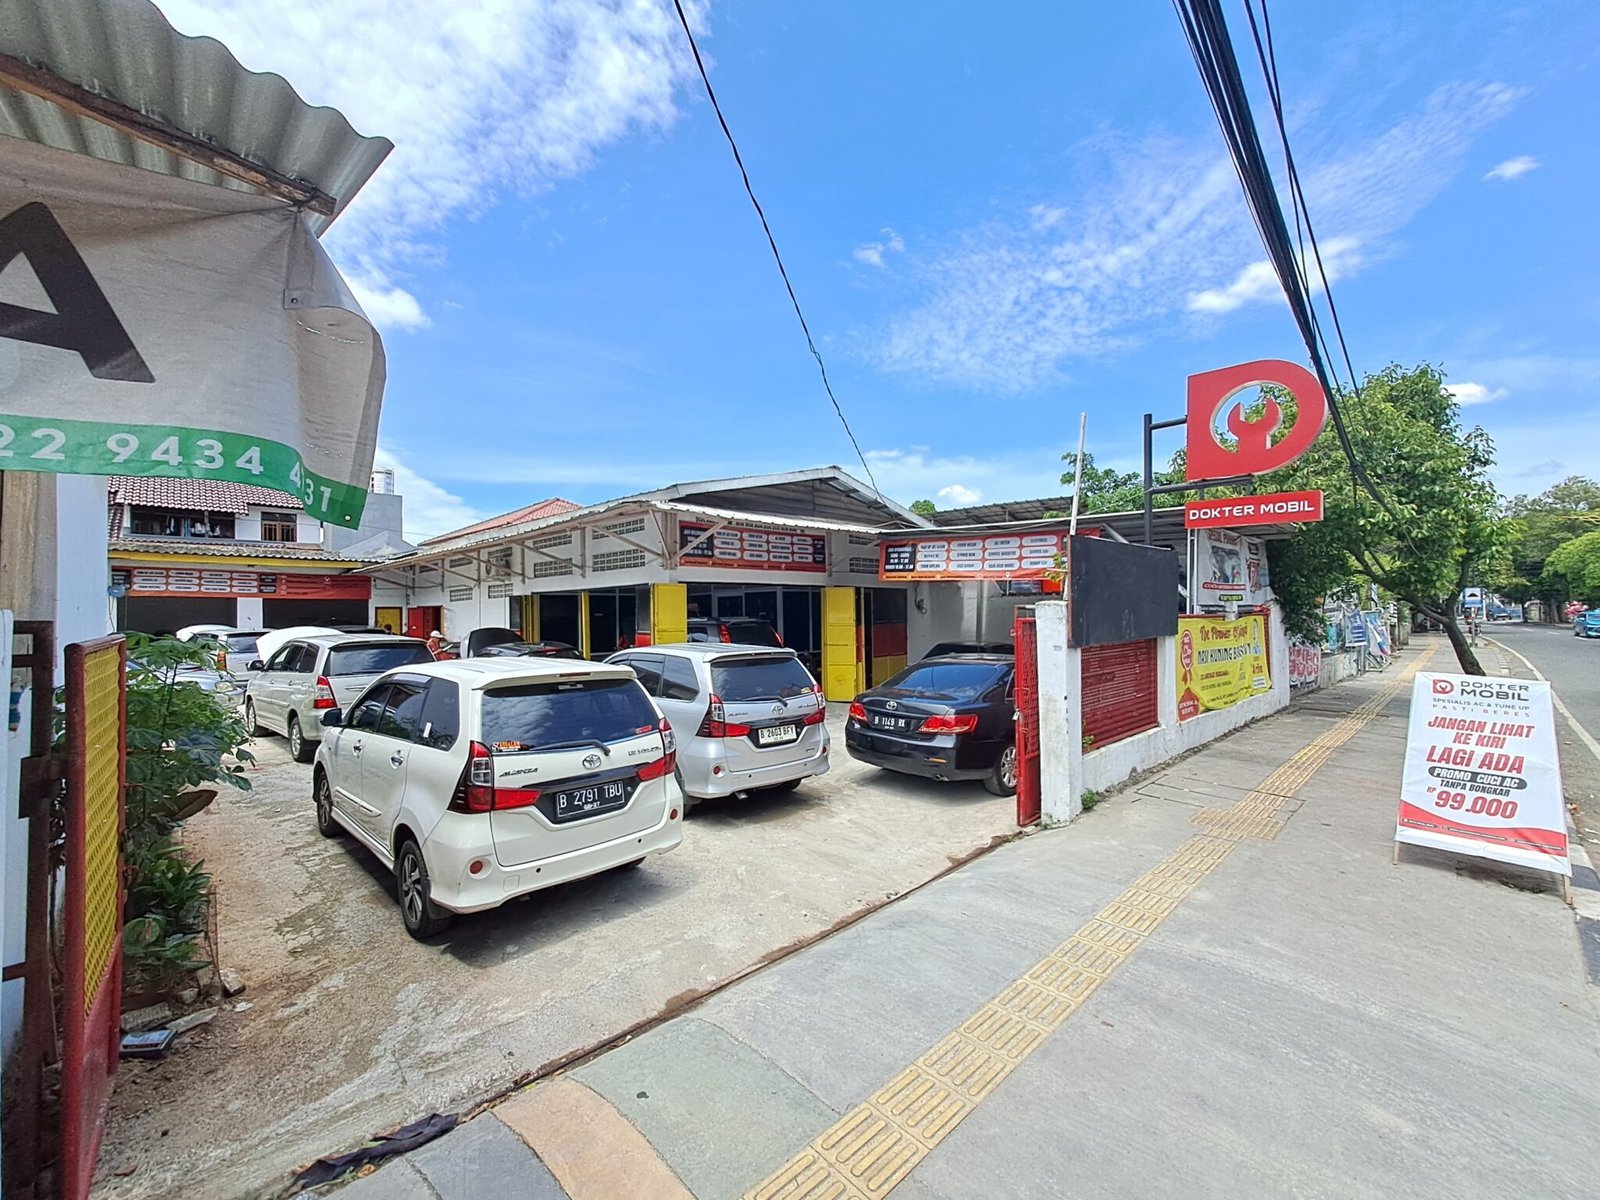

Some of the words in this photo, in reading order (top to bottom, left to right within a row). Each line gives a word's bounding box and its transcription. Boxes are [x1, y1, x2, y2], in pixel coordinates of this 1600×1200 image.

[106, 433, 263, 475] 9434
[1189, 504, 1255, 520] DOKTER
[1260, 500, 1315, 515] MOBIL
[1460, 681, 1529, 692] DOKTER
[1460, 688, 1529, 701] MOBIL
[1433, 698, 1471, 706] SPESIALIS
[874, 716, 879, 725] B
[1428, 716, 1487, 733] JANGAN
[1490, 722, 1535, 738] LIHAT
[760, 729, 765, 739] B
[783, 725, 794, 736] BFY
[1453, 732, 1473, 745] KE
[1475, 735, 1507, 749] KIRI
[1426, 745, 1475, 767] LAGI
[1478, 752, 1525, 774] ADA
[1433, 767, 1472, 781] PROMO
[1477, 774, 1501, 785] CUCI
[1503, 778, 1519, 788] AC
[560, 794, 567, 808] B
[573, 788, 598, 805] 2791
[603, 783, 622, 798] TBU
[1440, 780, 1467, 790] TANPA
[1469, 784, 1511, 797] BONGKAR
[1435, 790, 1518, 819] 99.000
